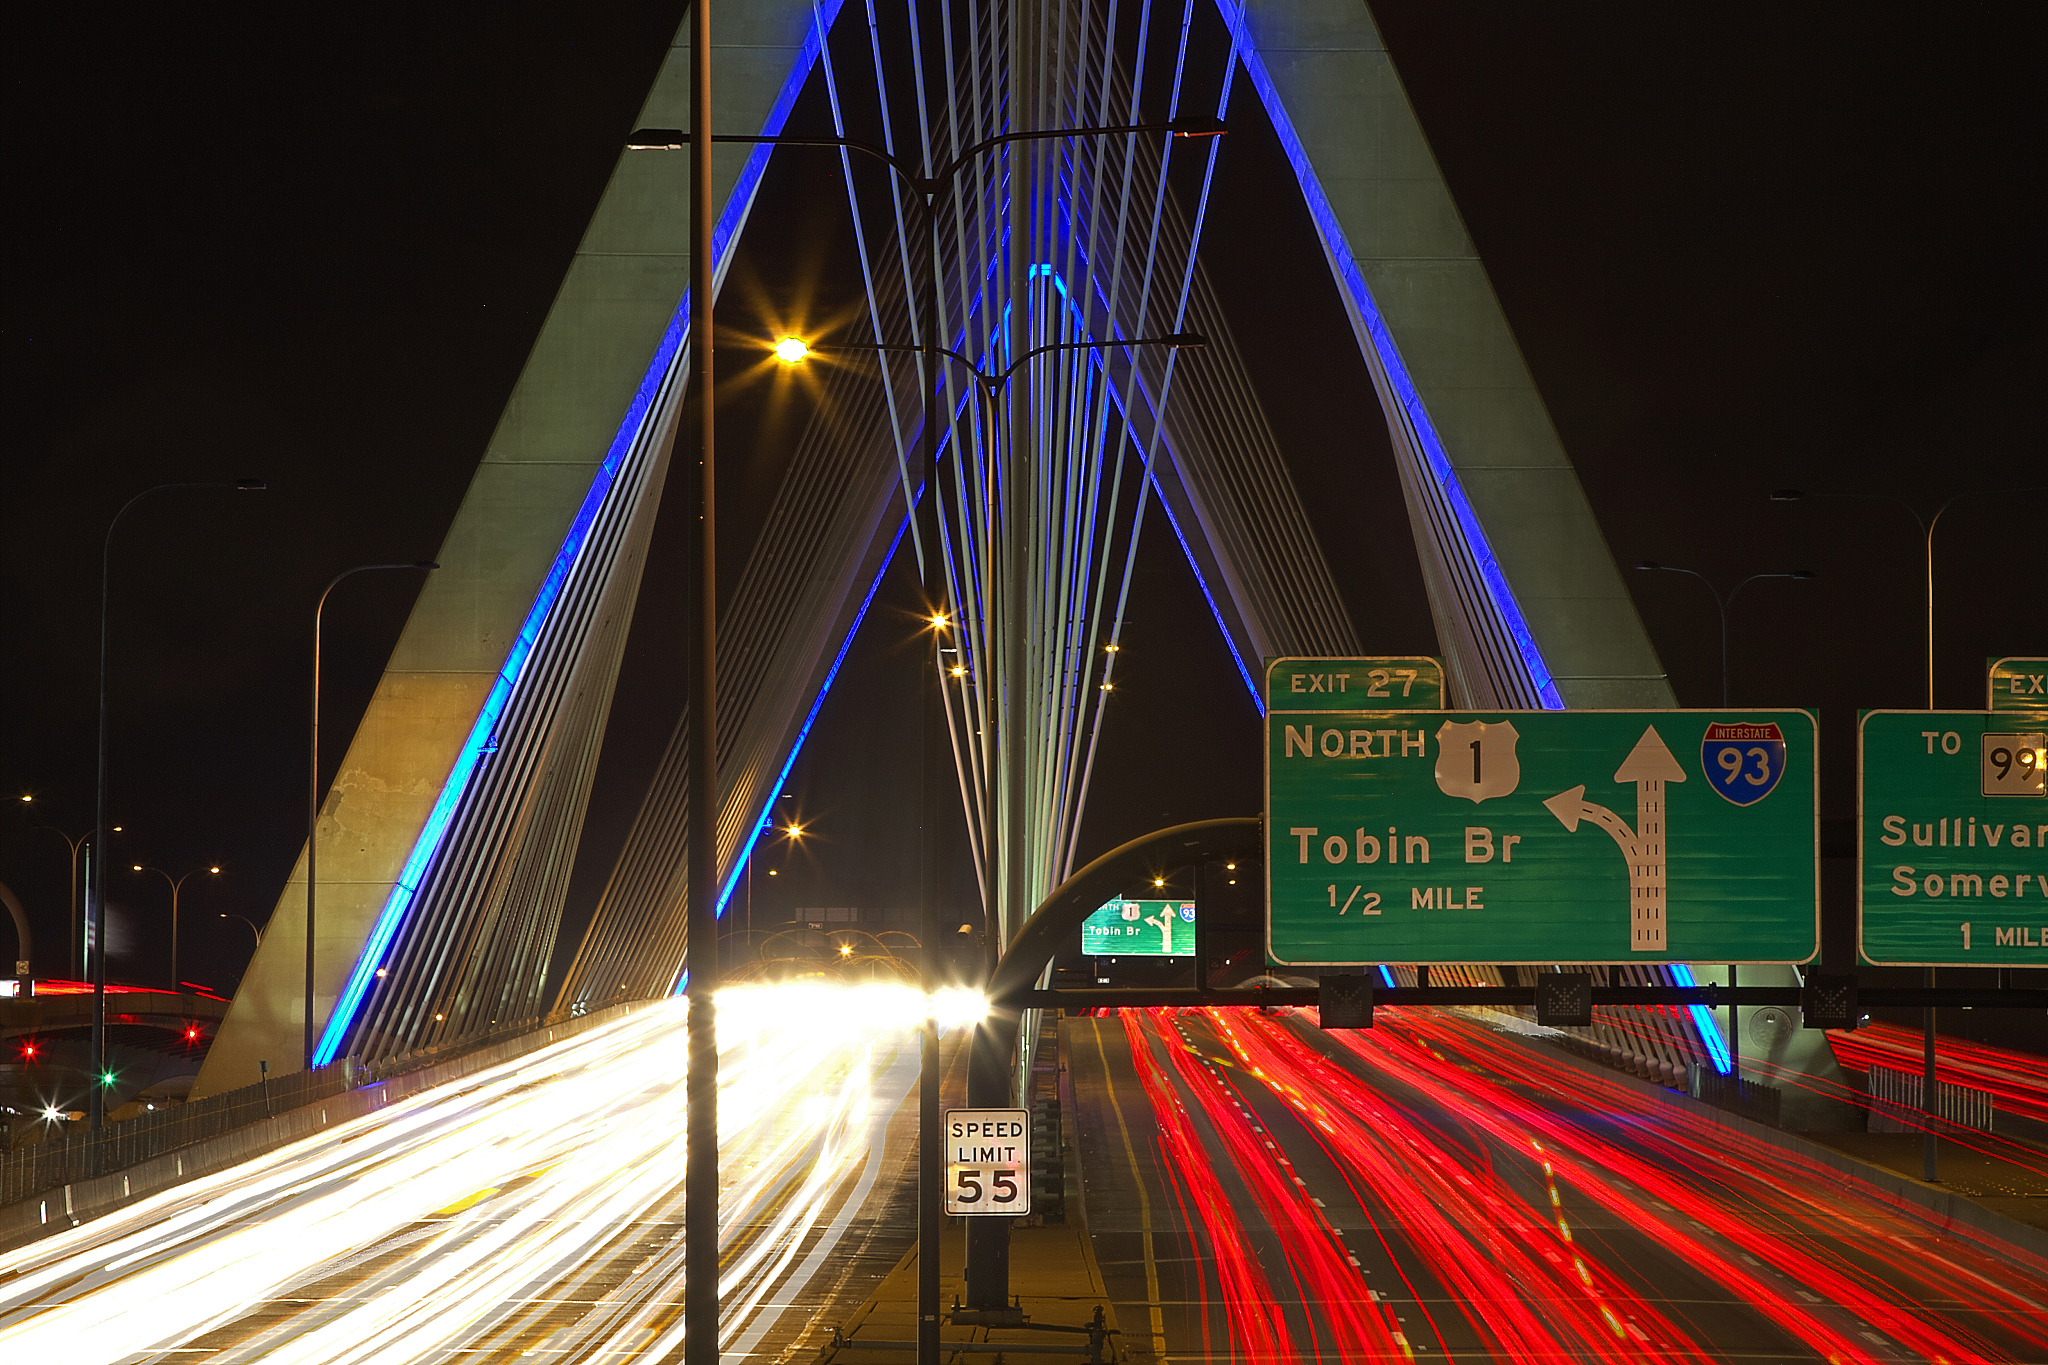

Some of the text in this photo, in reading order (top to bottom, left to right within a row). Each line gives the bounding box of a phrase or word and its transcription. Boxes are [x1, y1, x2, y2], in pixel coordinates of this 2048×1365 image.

[1291, 669, 1418, 697] EXIT 27
[2010, 674, 2048, 694] EX
[1284, 724, 1425, 758] NORTH
[1715, 728, 1771, 739] INTERSTATE
[1921, 731, 1961, 755] TO
[1469, 740, 1483, 784] 1
[1717, 747, 1770, 786] 93
[1990, 747, 2037, 781] 99
[1290, 826, 1521, 864] Tobin Br
[1327, 884, 1484, 915] 1/2 MILE
[1089, 925, 1141, 936] Tobin Br
[1960, 922, 1971, 950] 1
[952, 1122, 1023, 1138] SPEED
[958, 1146, 1016, 1163] LIMIT
[957, 1170, 1018, 1204] 55
